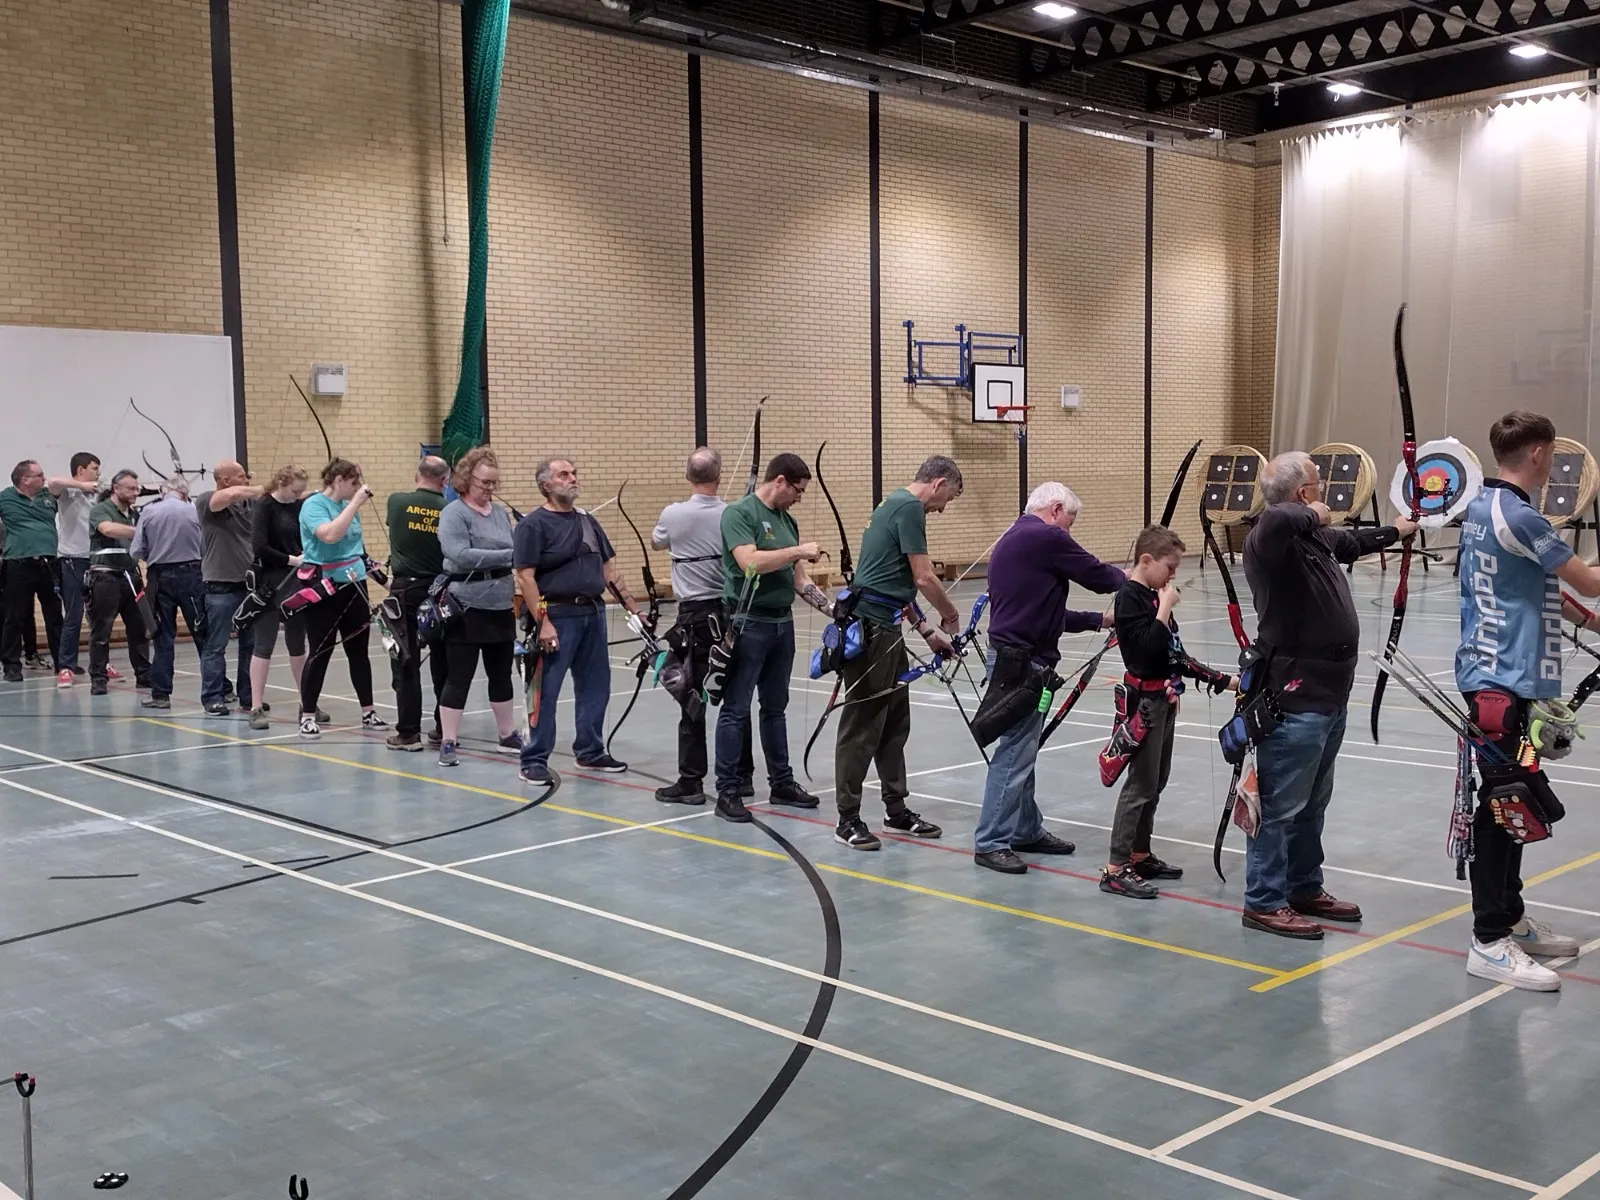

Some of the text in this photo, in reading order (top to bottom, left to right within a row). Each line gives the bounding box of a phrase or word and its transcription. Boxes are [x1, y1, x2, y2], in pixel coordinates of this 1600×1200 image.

[406, 505, 441, 517] ARCHE
[423, 517, 435, 526] of
[1540, 576, 1561, 680] Podiu
